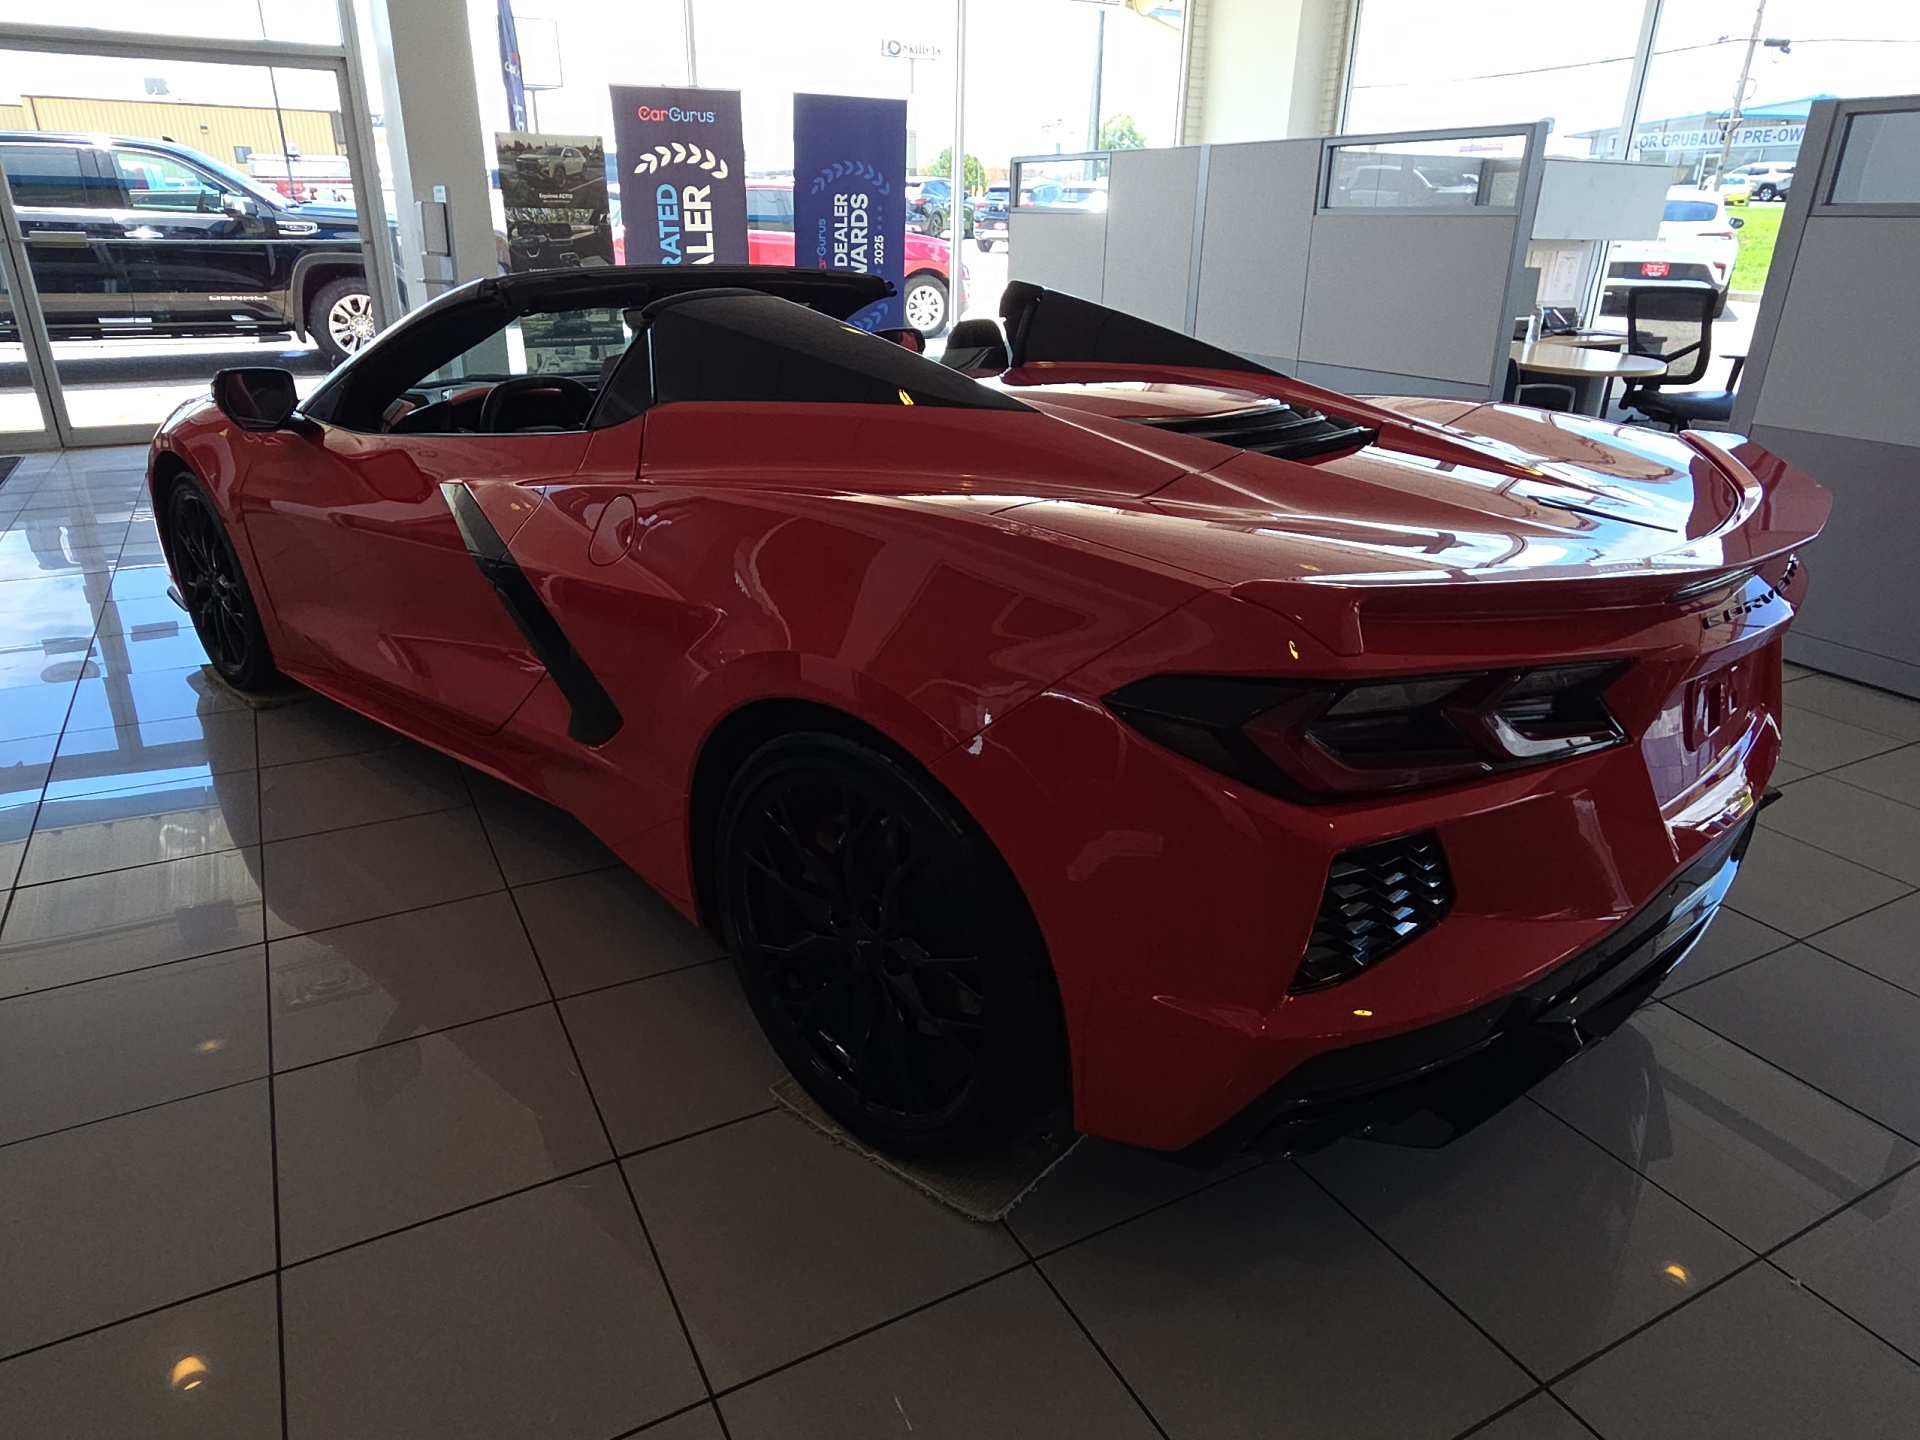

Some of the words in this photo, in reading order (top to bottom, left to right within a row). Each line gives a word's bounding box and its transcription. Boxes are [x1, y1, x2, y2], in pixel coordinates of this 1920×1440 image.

[637, 105, 715, 123] CarGurus
[1661, 131, 1739, 148] GRUBAUH
[656, 183, 682, 265] RATED
[834, 193, 848, 267] DEALER
[874, 235, 884, 265] 2025
